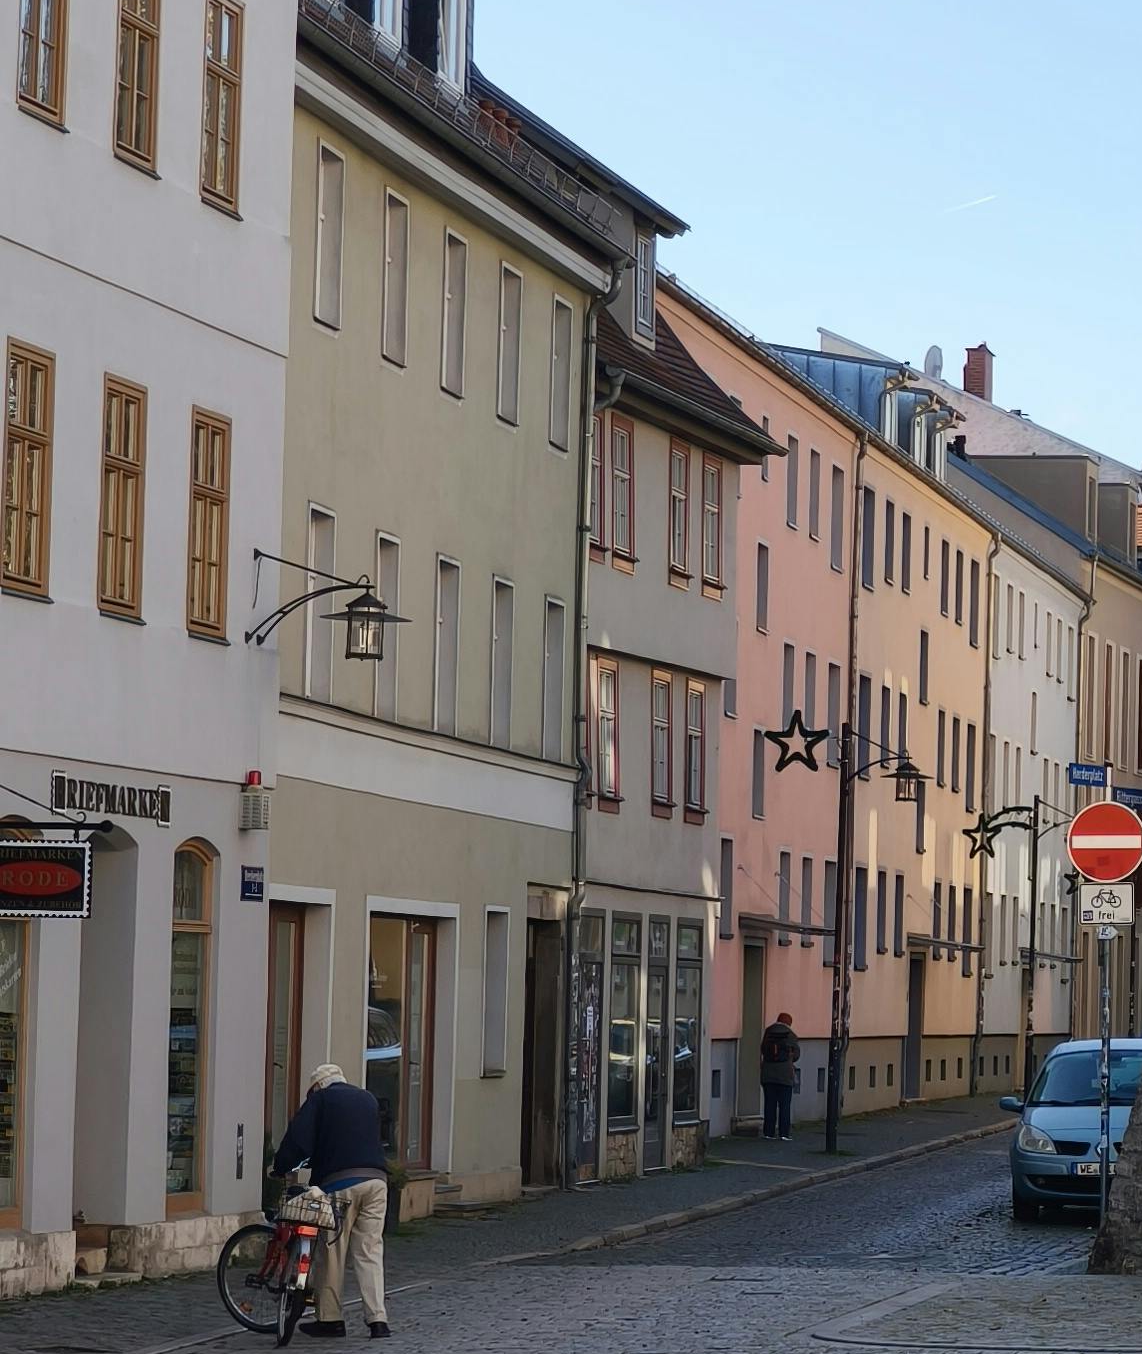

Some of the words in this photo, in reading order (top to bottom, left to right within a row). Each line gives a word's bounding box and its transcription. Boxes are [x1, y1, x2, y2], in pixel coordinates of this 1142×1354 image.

[2, 869, 69, 887] RODE
[1098, 910, 1115, 921] frei
[1080, 1164, 1093, 1174] WE
